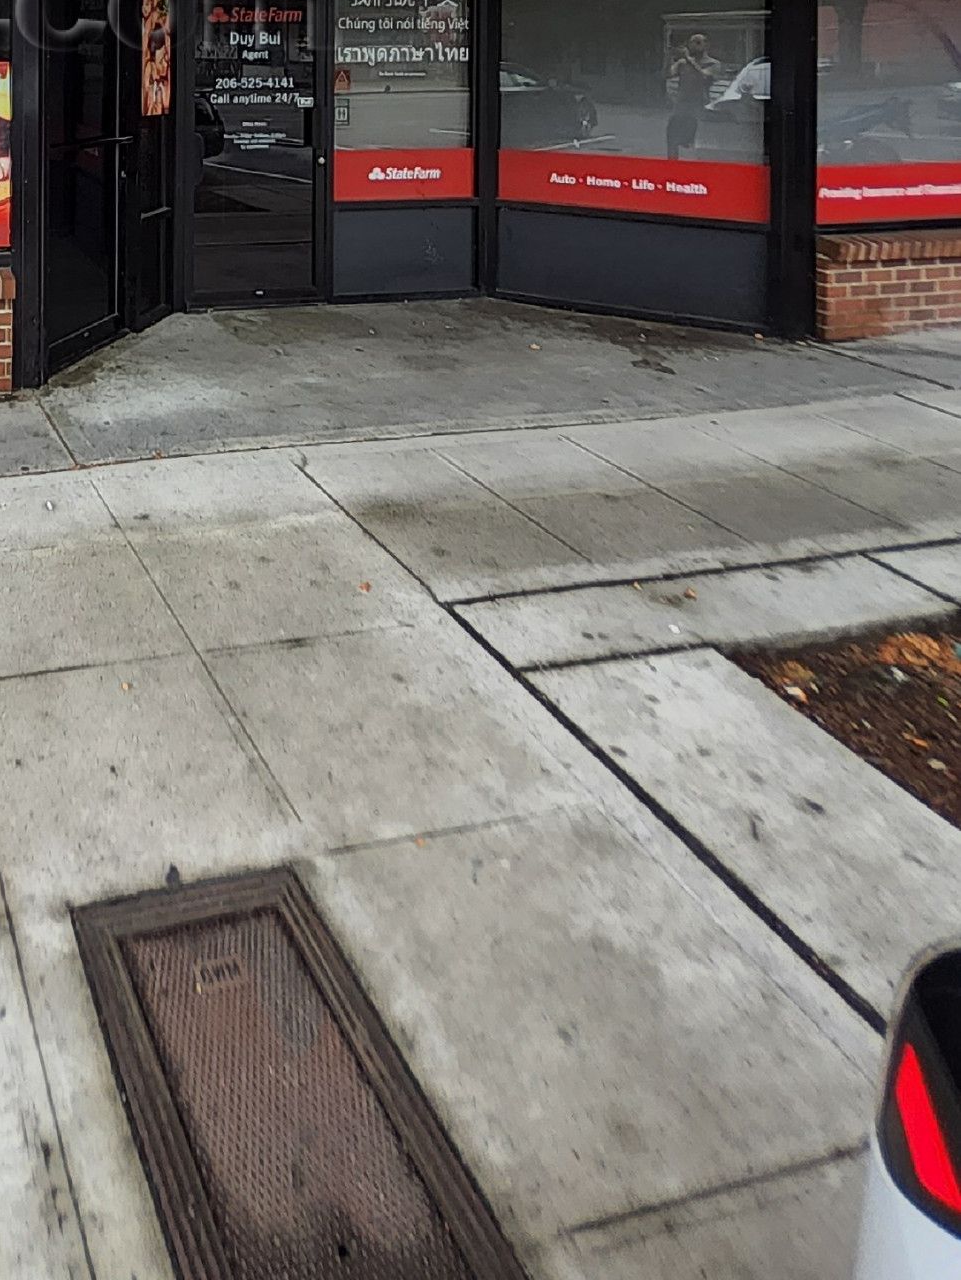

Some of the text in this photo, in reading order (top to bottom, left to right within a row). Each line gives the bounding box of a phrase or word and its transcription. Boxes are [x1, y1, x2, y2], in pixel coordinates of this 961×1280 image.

[231, 7, 303, 24] StateFarm
[230, 31, 255, 47] Duy
[242, 50, 269, 61] Agent
[215, 78, 295, 90] 206-525-4141
[210, 93, 230, 105] Call
[232, 93, 272, 107] anytime
[275, 92, 300, 105] 24/7
[385, 167, 441, 180] StateFarm
[550, 172, 708, 195] Auto Home Life Health
